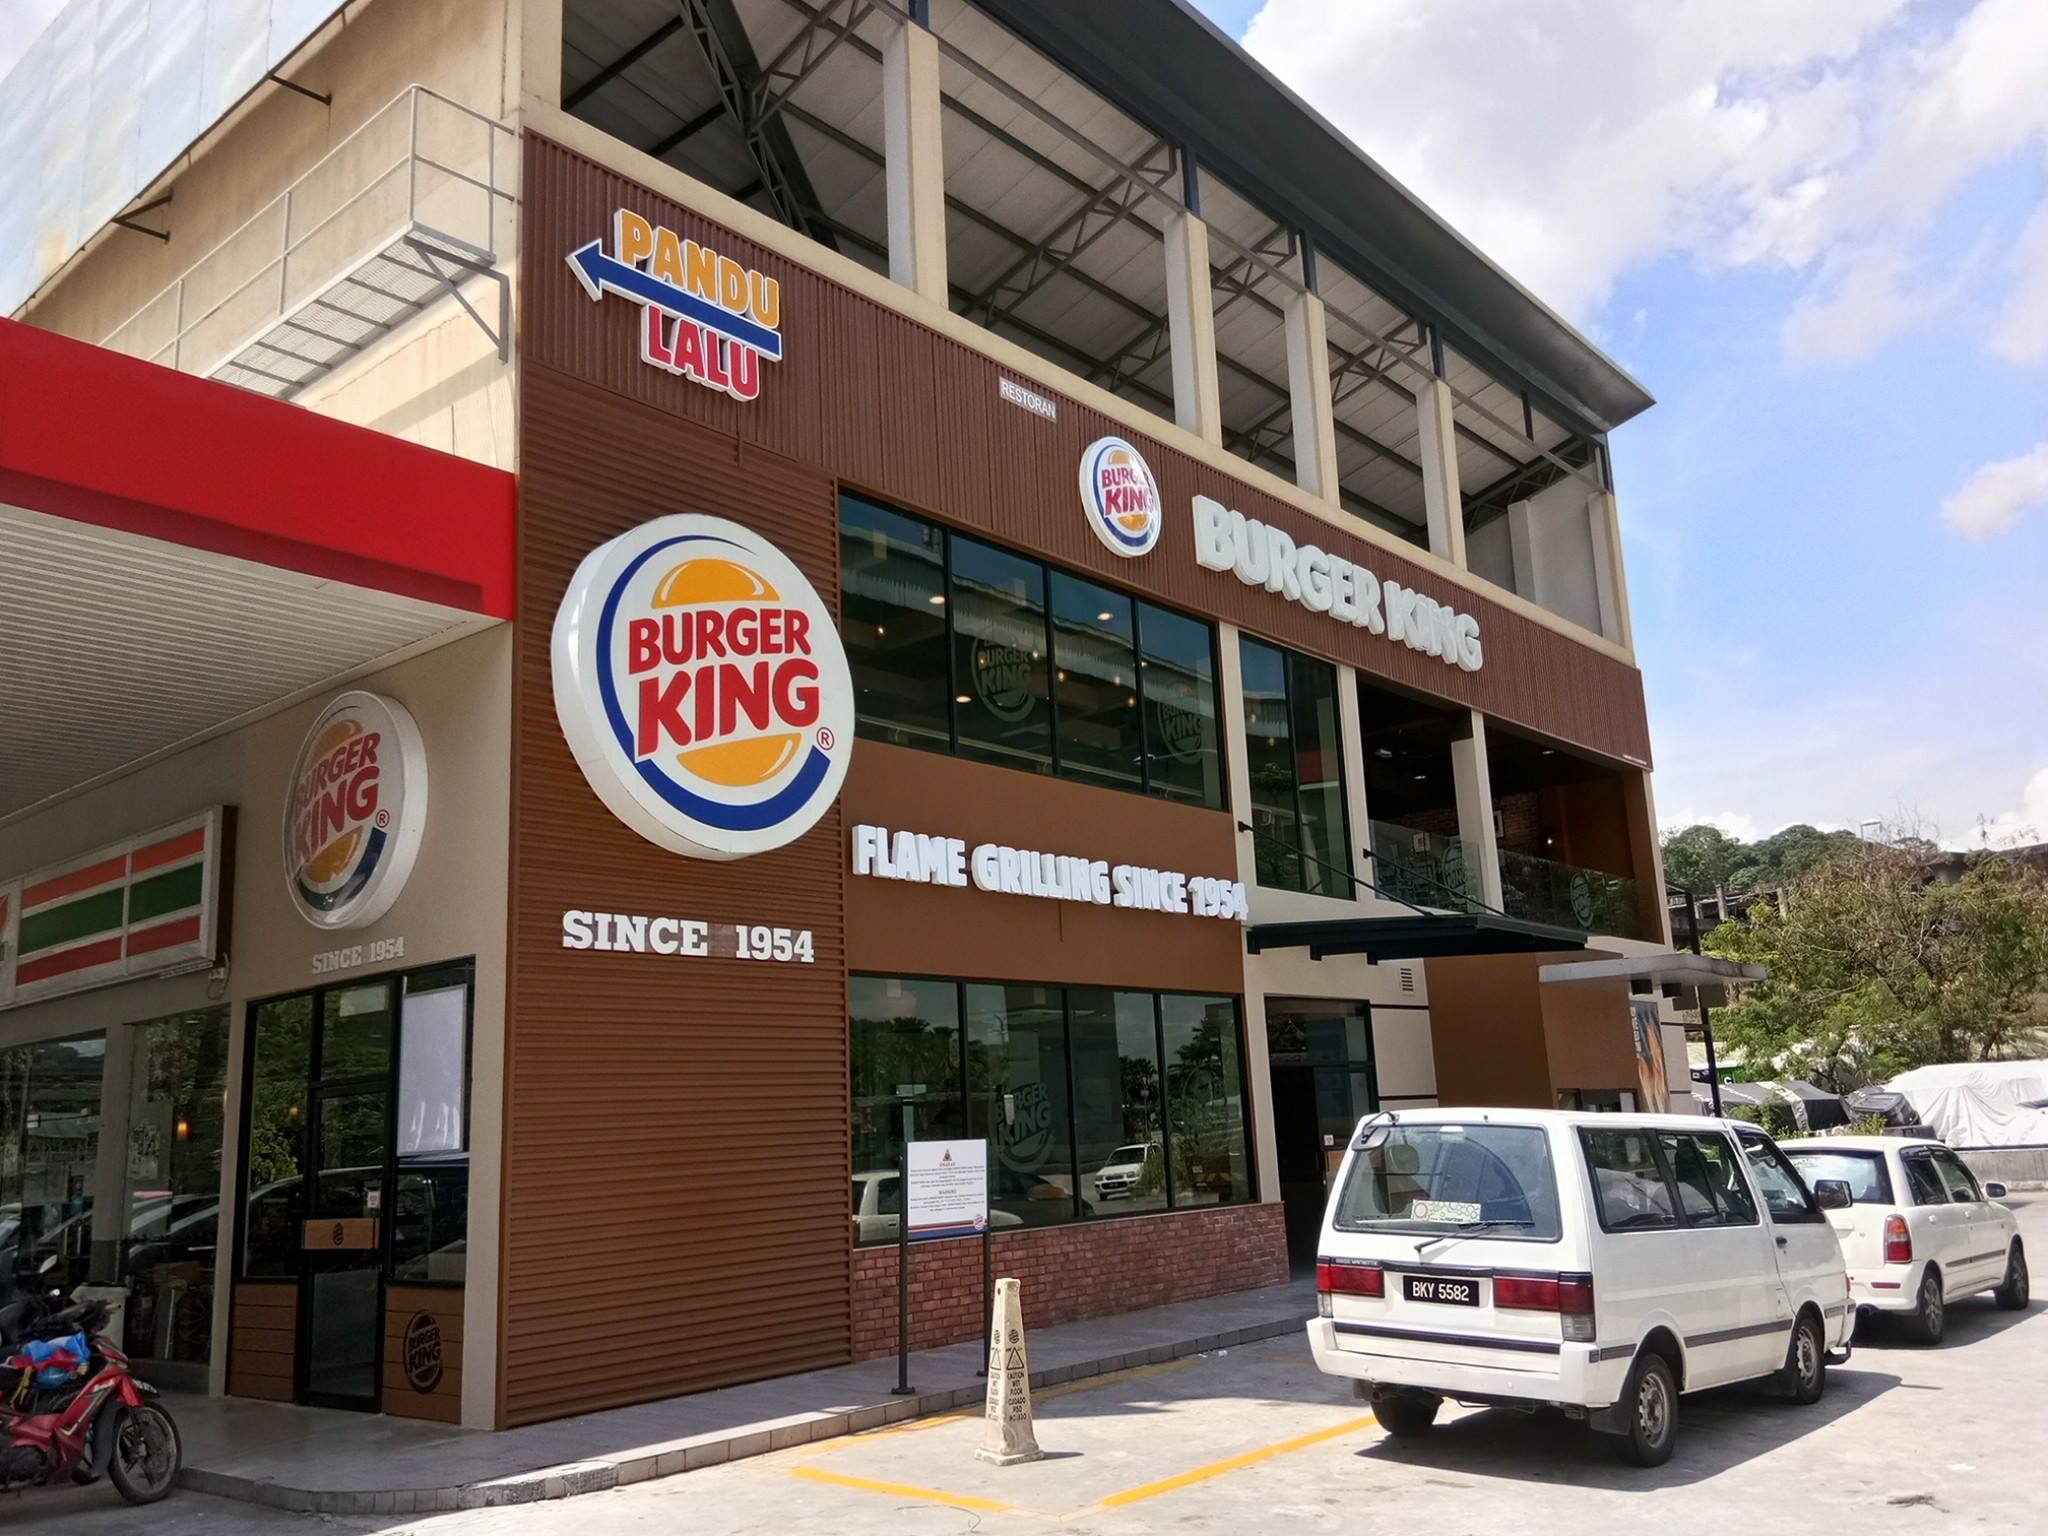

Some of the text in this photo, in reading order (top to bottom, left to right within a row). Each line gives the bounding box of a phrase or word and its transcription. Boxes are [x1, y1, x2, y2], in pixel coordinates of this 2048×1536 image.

[614, 208, 780, 330] PANDU
[641, 304, 760, 402] LALU
[1001, 381, 1055, 418] RESTORAN
[1101, 467, 1148, 489] BURG
[1105, 486, 1153, 516] KING
[1193, 494, 1484, 672] BURGER KING
[628, 608, 812, 675] BURGER
[638, 659, 820, 757] KING
[295, 765, 380, 862] KING
[852, 824, 1249, 923] FLAME GRILLING SINCE 1954
[311, 936, 405, 975] SINCE 1954
[562, 910, 816, 964] SINCE 1954
[996, 1083, 1048, 1123] BRGER
[1412, 1281, 1470, 1301] BKY 5582
[409, 1341, 440, 1374] KING
